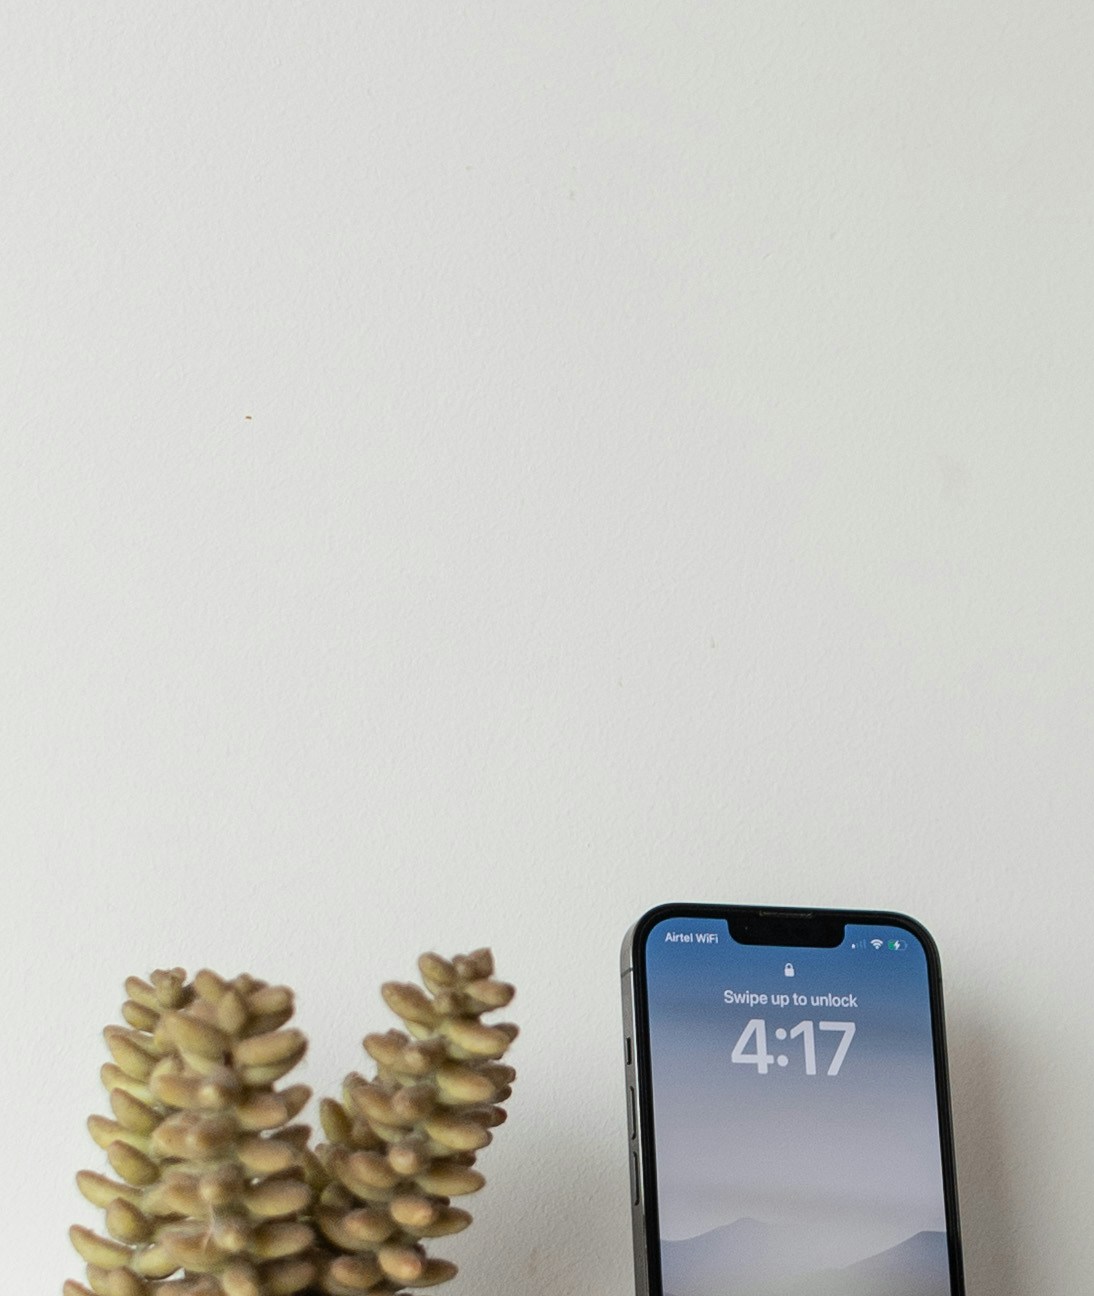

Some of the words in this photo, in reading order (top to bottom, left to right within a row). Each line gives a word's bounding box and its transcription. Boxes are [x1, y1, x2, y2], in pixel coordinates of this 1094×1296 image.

[665, 932, 693, 943] Airtel
[695, 933, 719, 944] WiFi
[724, 989, 768, 1007] Swipe
[771, 992, 790, 1008] up
[792, 992, 807, 1006] to
[811, 993, 858, 1007] unlock
[731, 1018, 856, 1076] 4:17
